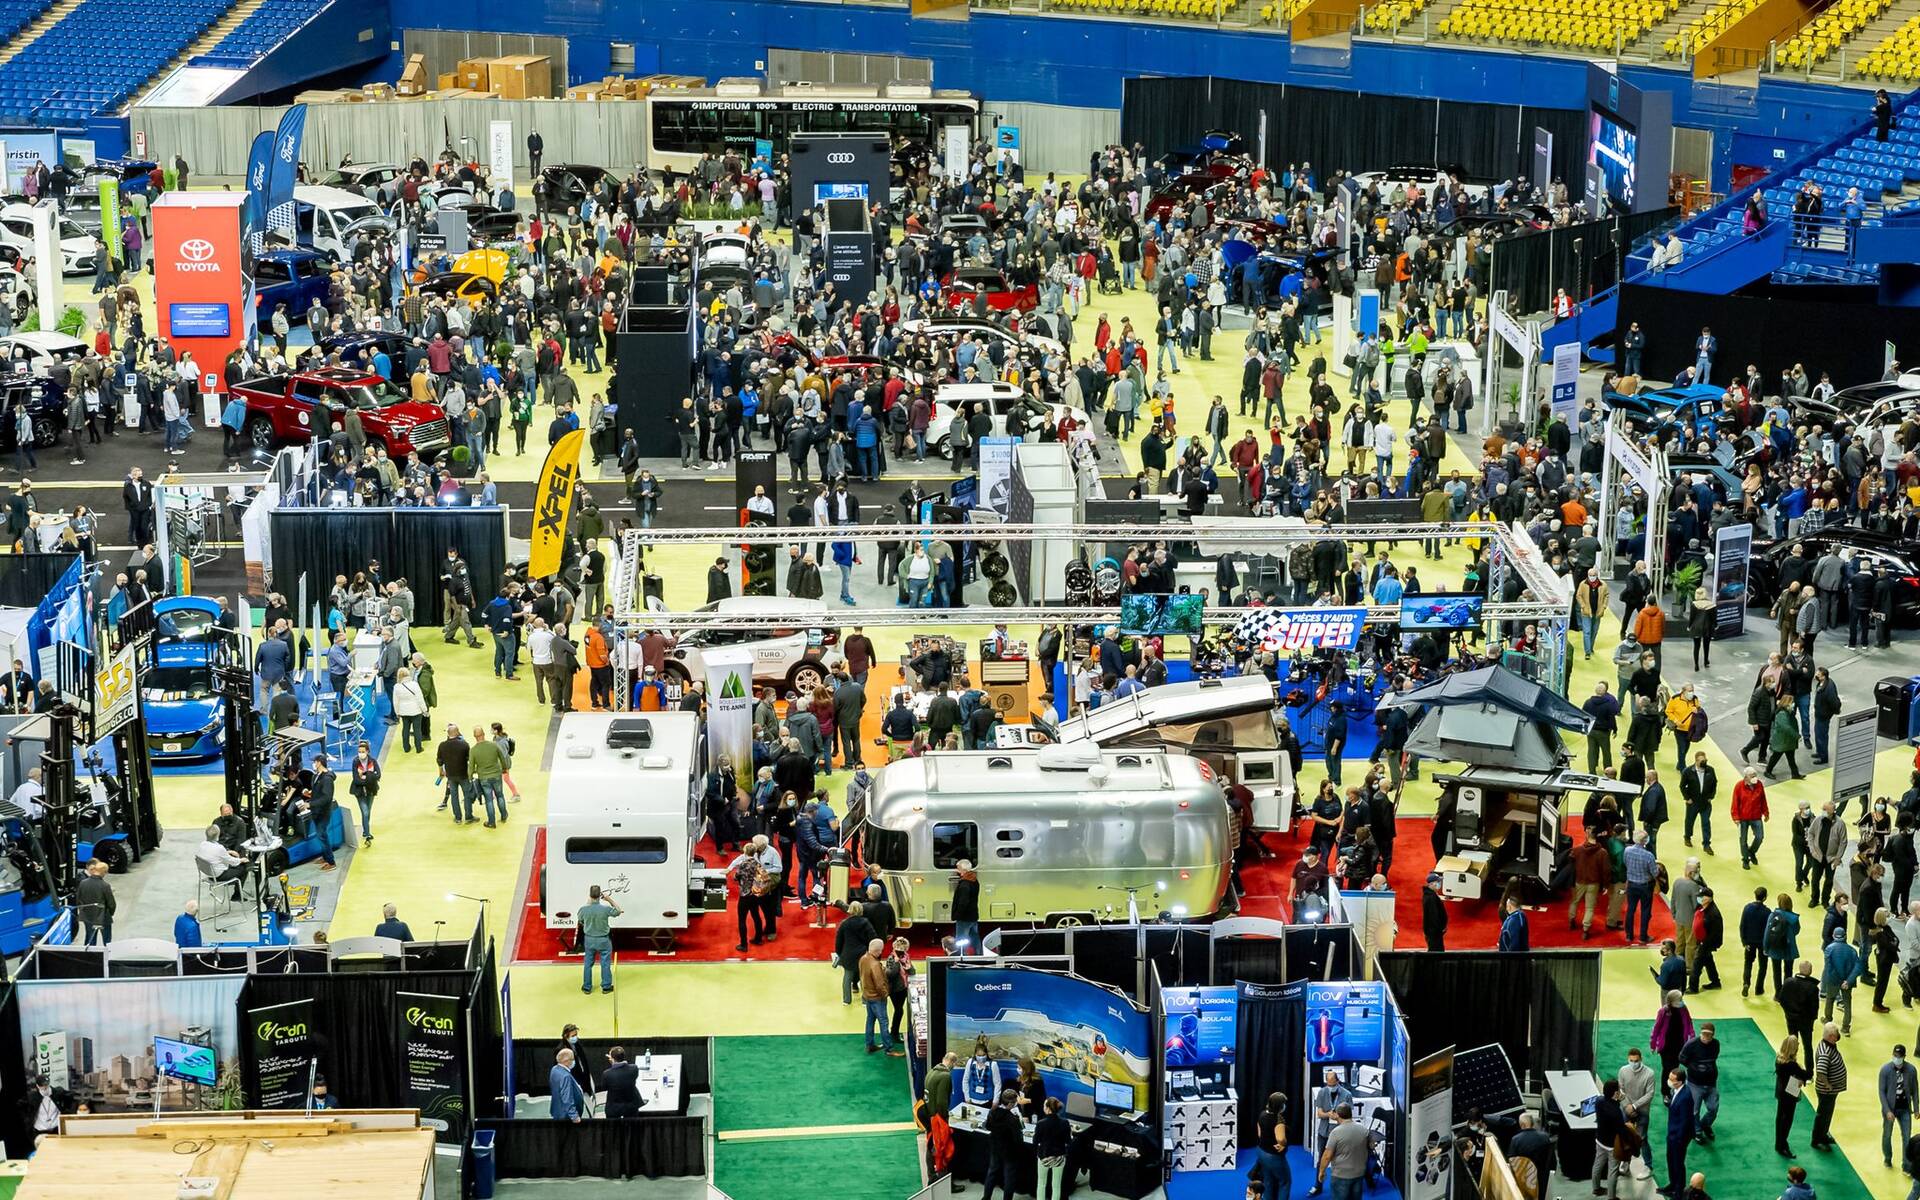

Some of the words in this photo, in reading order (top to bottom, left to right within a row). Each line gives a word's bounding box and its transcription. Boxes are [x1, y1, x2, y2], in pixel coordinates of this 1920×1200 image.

[699, 102, 751, 110] IMPERIUM
[755, 102, 778, 110] 100%
[792, 103, 834, 111] ELECTRIC
[841, 103, 918, 112] TRANSPORTATION
[281, 134, 295, 163] Ford
[6, 150, 40, 159] ristin
[253, 161, 265, 191] Ford
[175, 262, 221, 272] TOYOTA
[740, 453, 771, 462] FAST
[537, 463, 572, 538] XPEL
[1291, 612, 1322, 622] PIÈCES
[1323, 613, 1354, 623] D'AUTO
[1260, 622, 1355, 651] SUPER
[974, 983, 1002, 992] Québec
[1254, 989, 1282, 997] Solution
